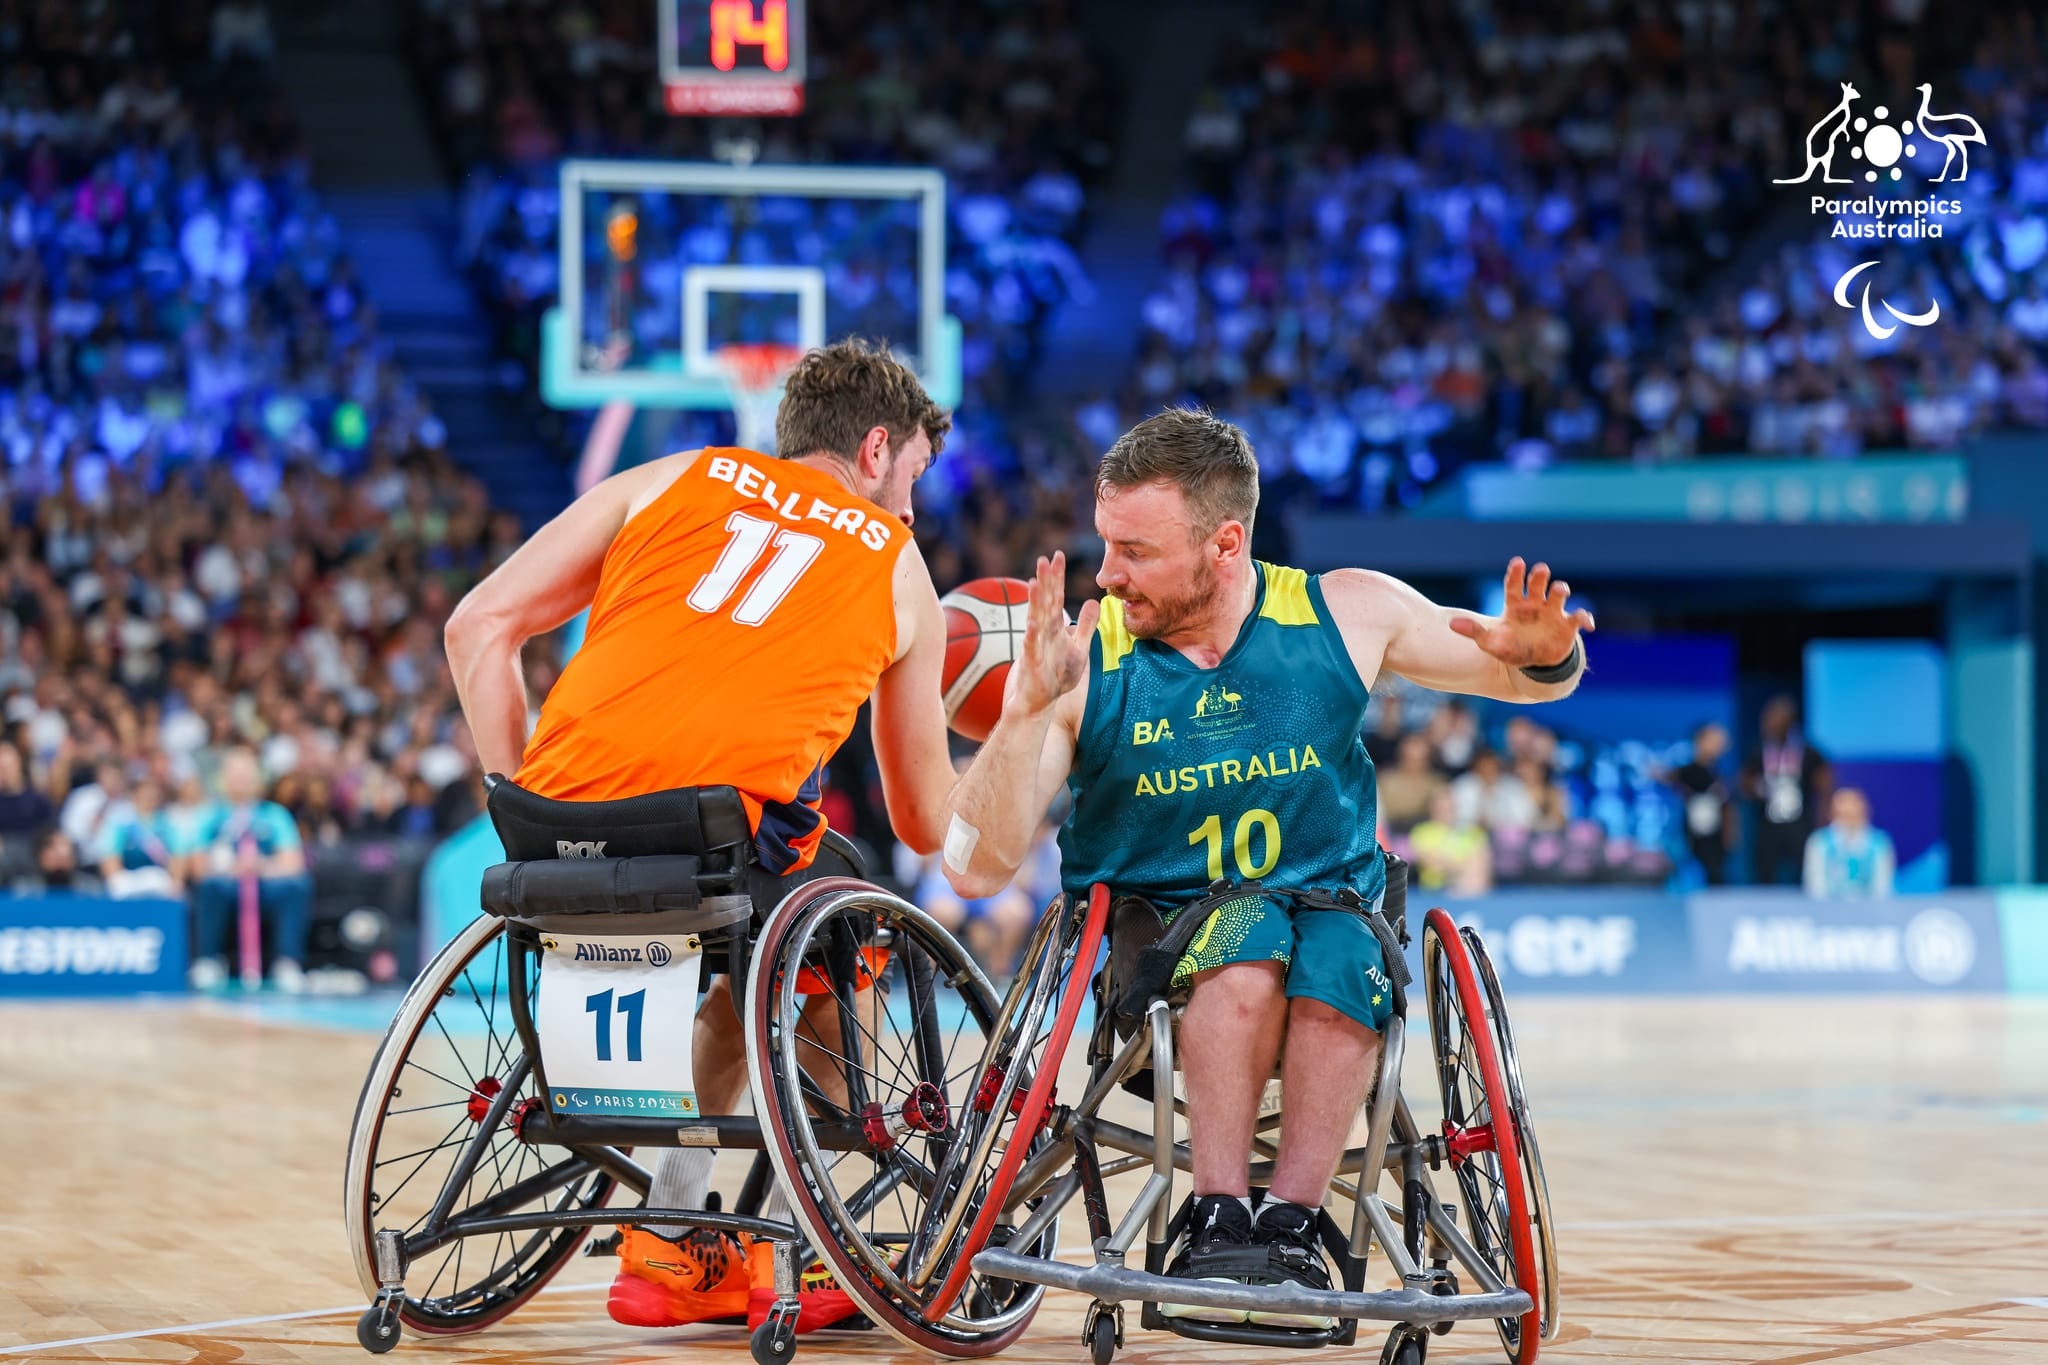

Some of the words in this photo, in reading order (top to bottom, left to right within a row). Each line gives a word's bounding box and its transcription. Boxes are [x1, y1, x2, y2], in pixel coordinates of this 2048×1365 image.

[710, 0, 788, 71] 14
[708, 457, 890, 551] BELLERS
[686, 511, 825, 627] 11
[1135, 745, 1322, 797] AUSTRALIA
[1188, 809, 1281, 881] 10
[574, 943, 643, 963] Allianz
[1365, 965, 1389, 992] AUS
[586, 987, 646, 1062] 11
[638, 1097, 677, 1109] 2024
